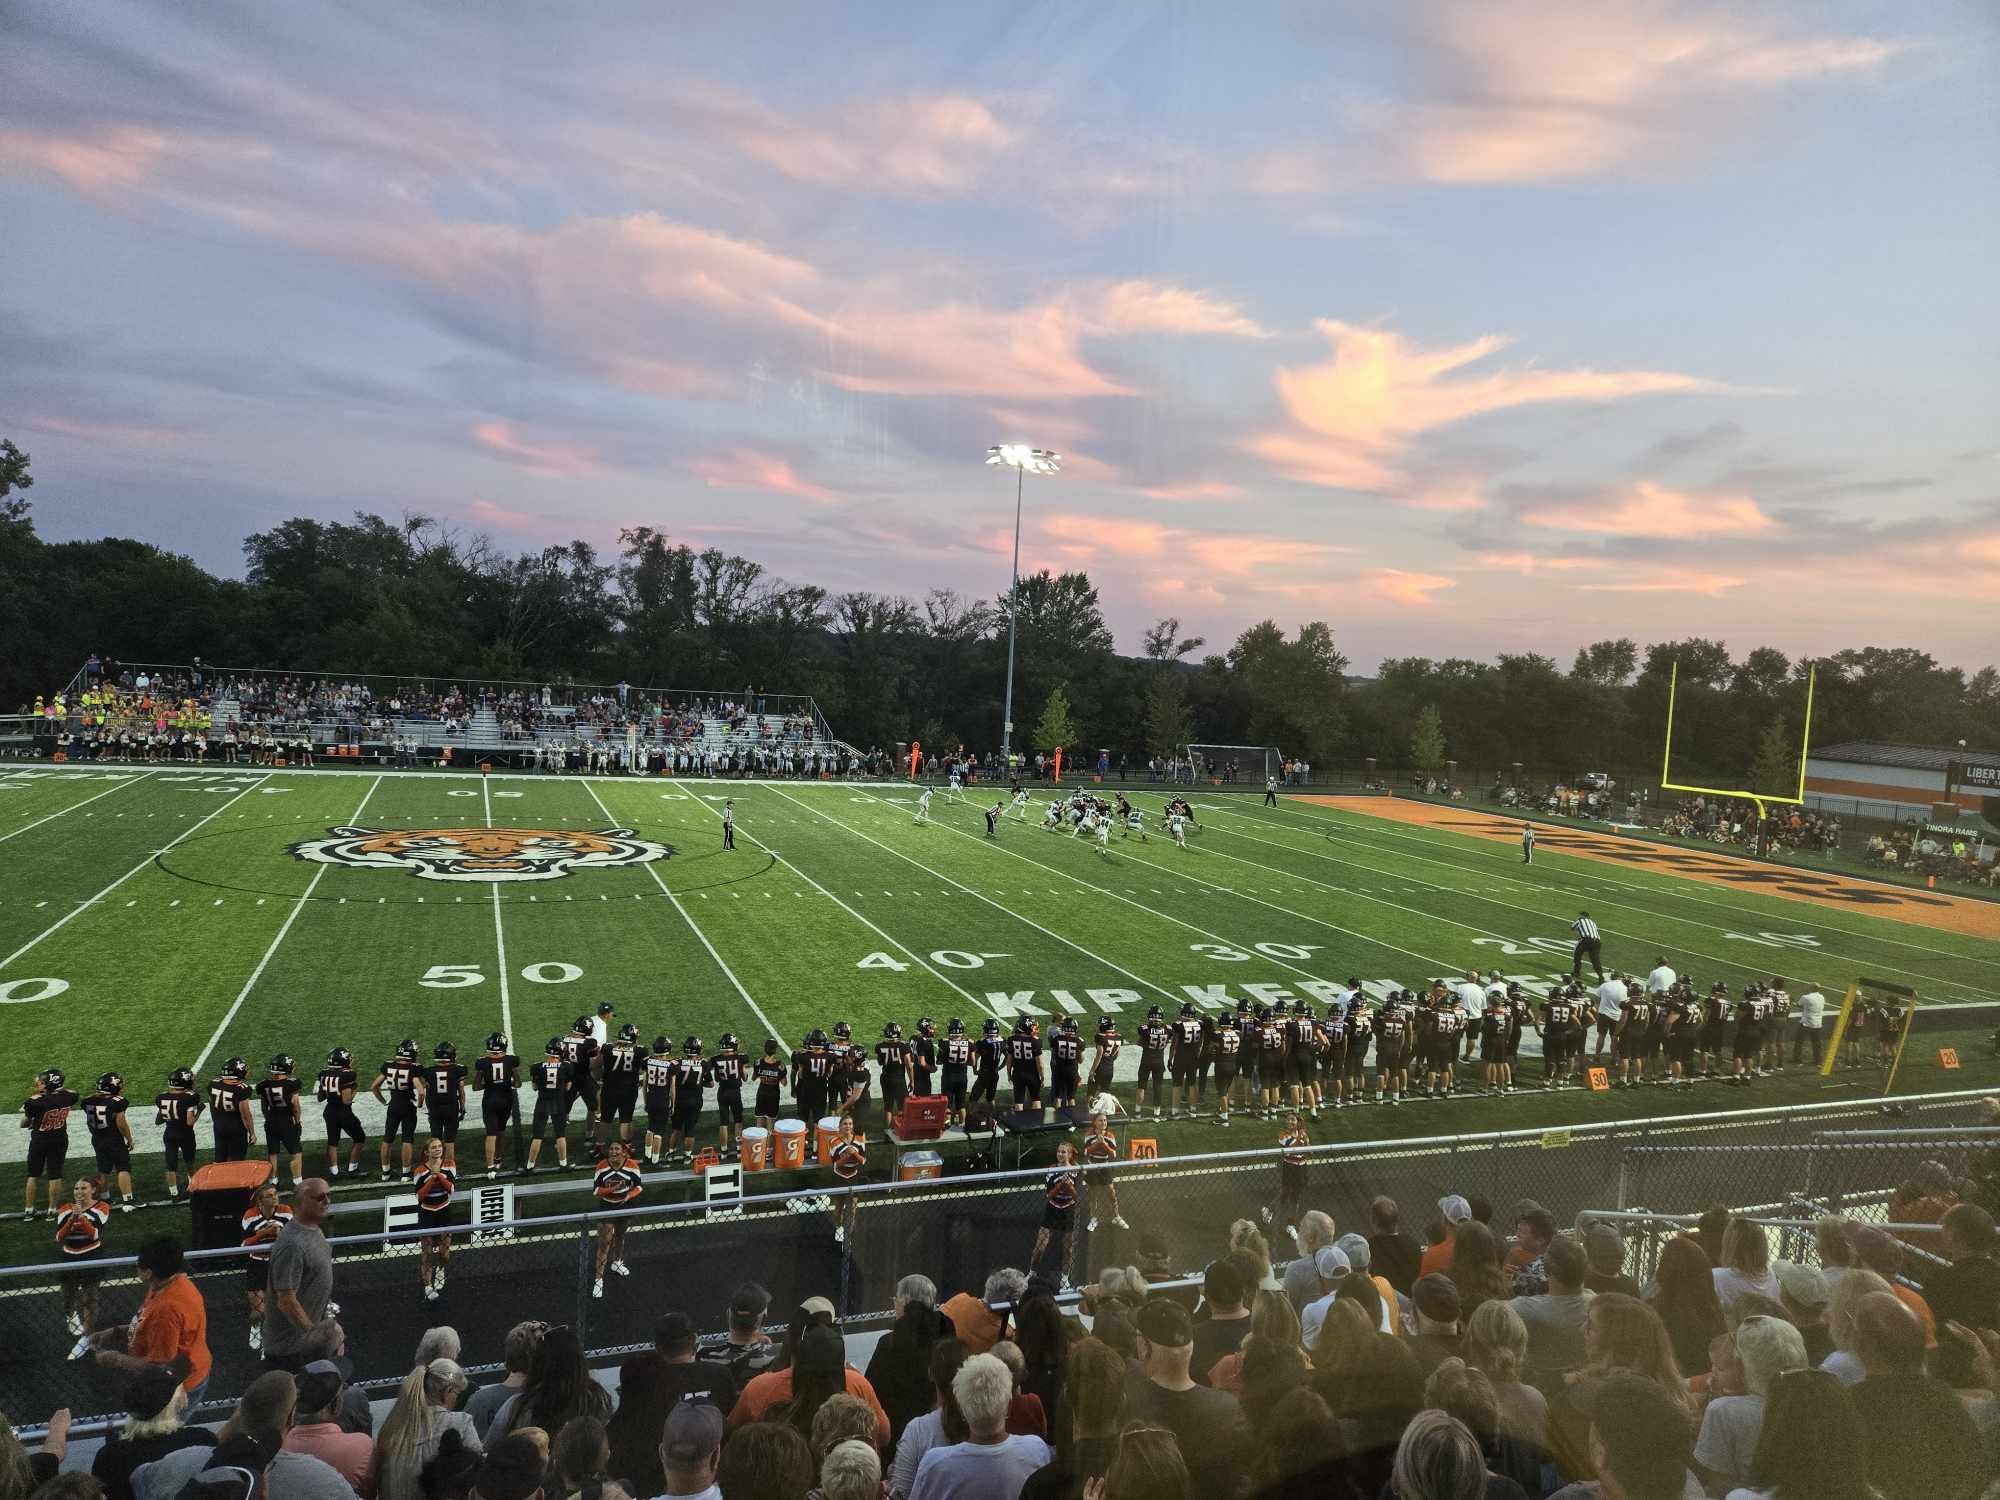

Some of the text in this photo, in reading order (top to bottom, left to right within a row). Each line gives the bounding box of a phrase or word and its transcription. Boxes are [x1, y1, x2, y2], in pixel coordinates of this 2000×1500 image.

[1925, 823, 1953, 833] TINORA
[856, 950, 984, 971] 40
[1190, 942, 1311, 961] 30
[418, 962, 583, 988] 50
[986, 988, 1143, 1017] KIP
[1591, 1071, 1608, 1087] 30
[481, 1188, 504, 1239] DEFENE
